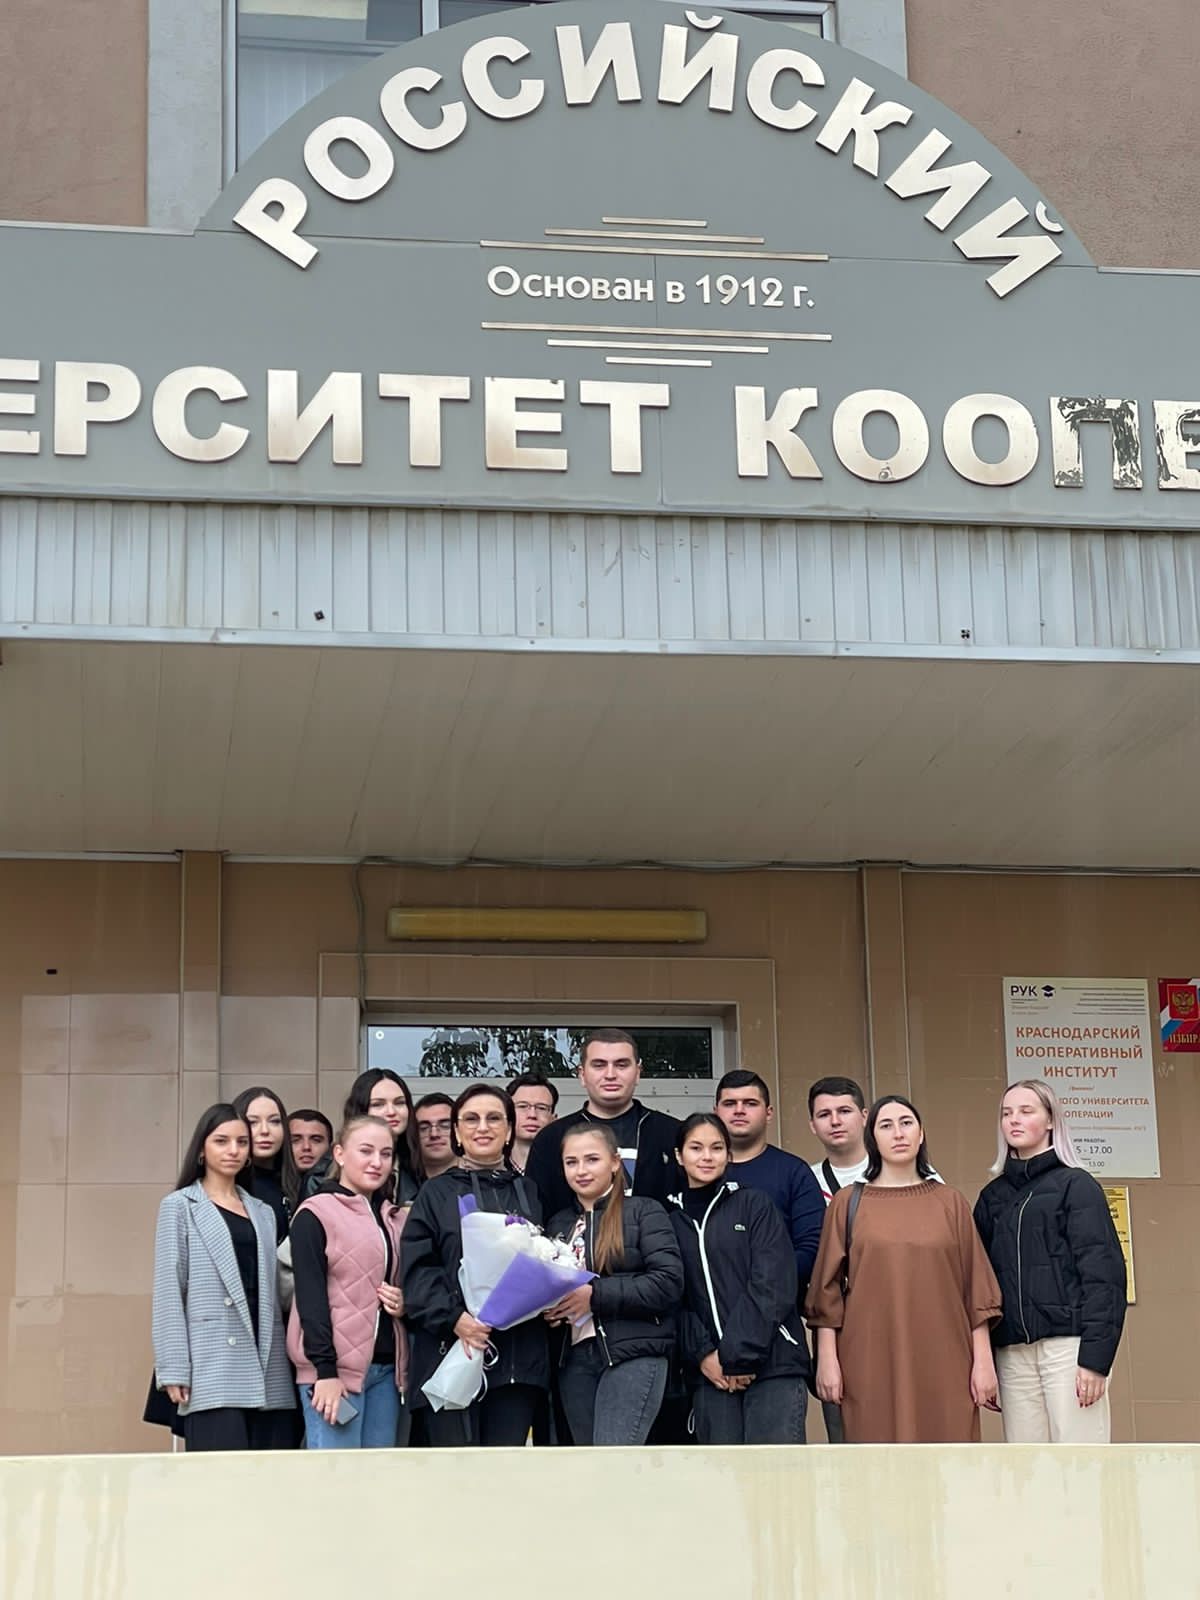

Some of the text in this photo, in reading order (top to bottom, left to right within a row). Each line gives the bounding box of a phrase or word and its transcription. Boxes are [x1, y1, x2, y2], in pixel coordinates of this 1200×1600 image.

[233, 11, 1064, 299] РОССИЙСКИЙ
[665, 279, 686, 304] в
[695, 273, 784, 308] 1912
[792, 284, 816, 308] г.
[1010, 985, 1038, 997] РУК
[1016, 1025, 1140, 1041] КРАСНОДАРСКИЙ
[1168, 1033, 1200, 1046] ИЗБИР
[1016, 1045, 1143, 1059] КООПЕРАТИВНЫЙ
[1044, 1066, 1118, 1078] ИНСТИТУТ
[1081, 1097, 1149, 1105] УНИВЕРСИТЕТА
[1089, 1146, 1113, 1154] 17.00
